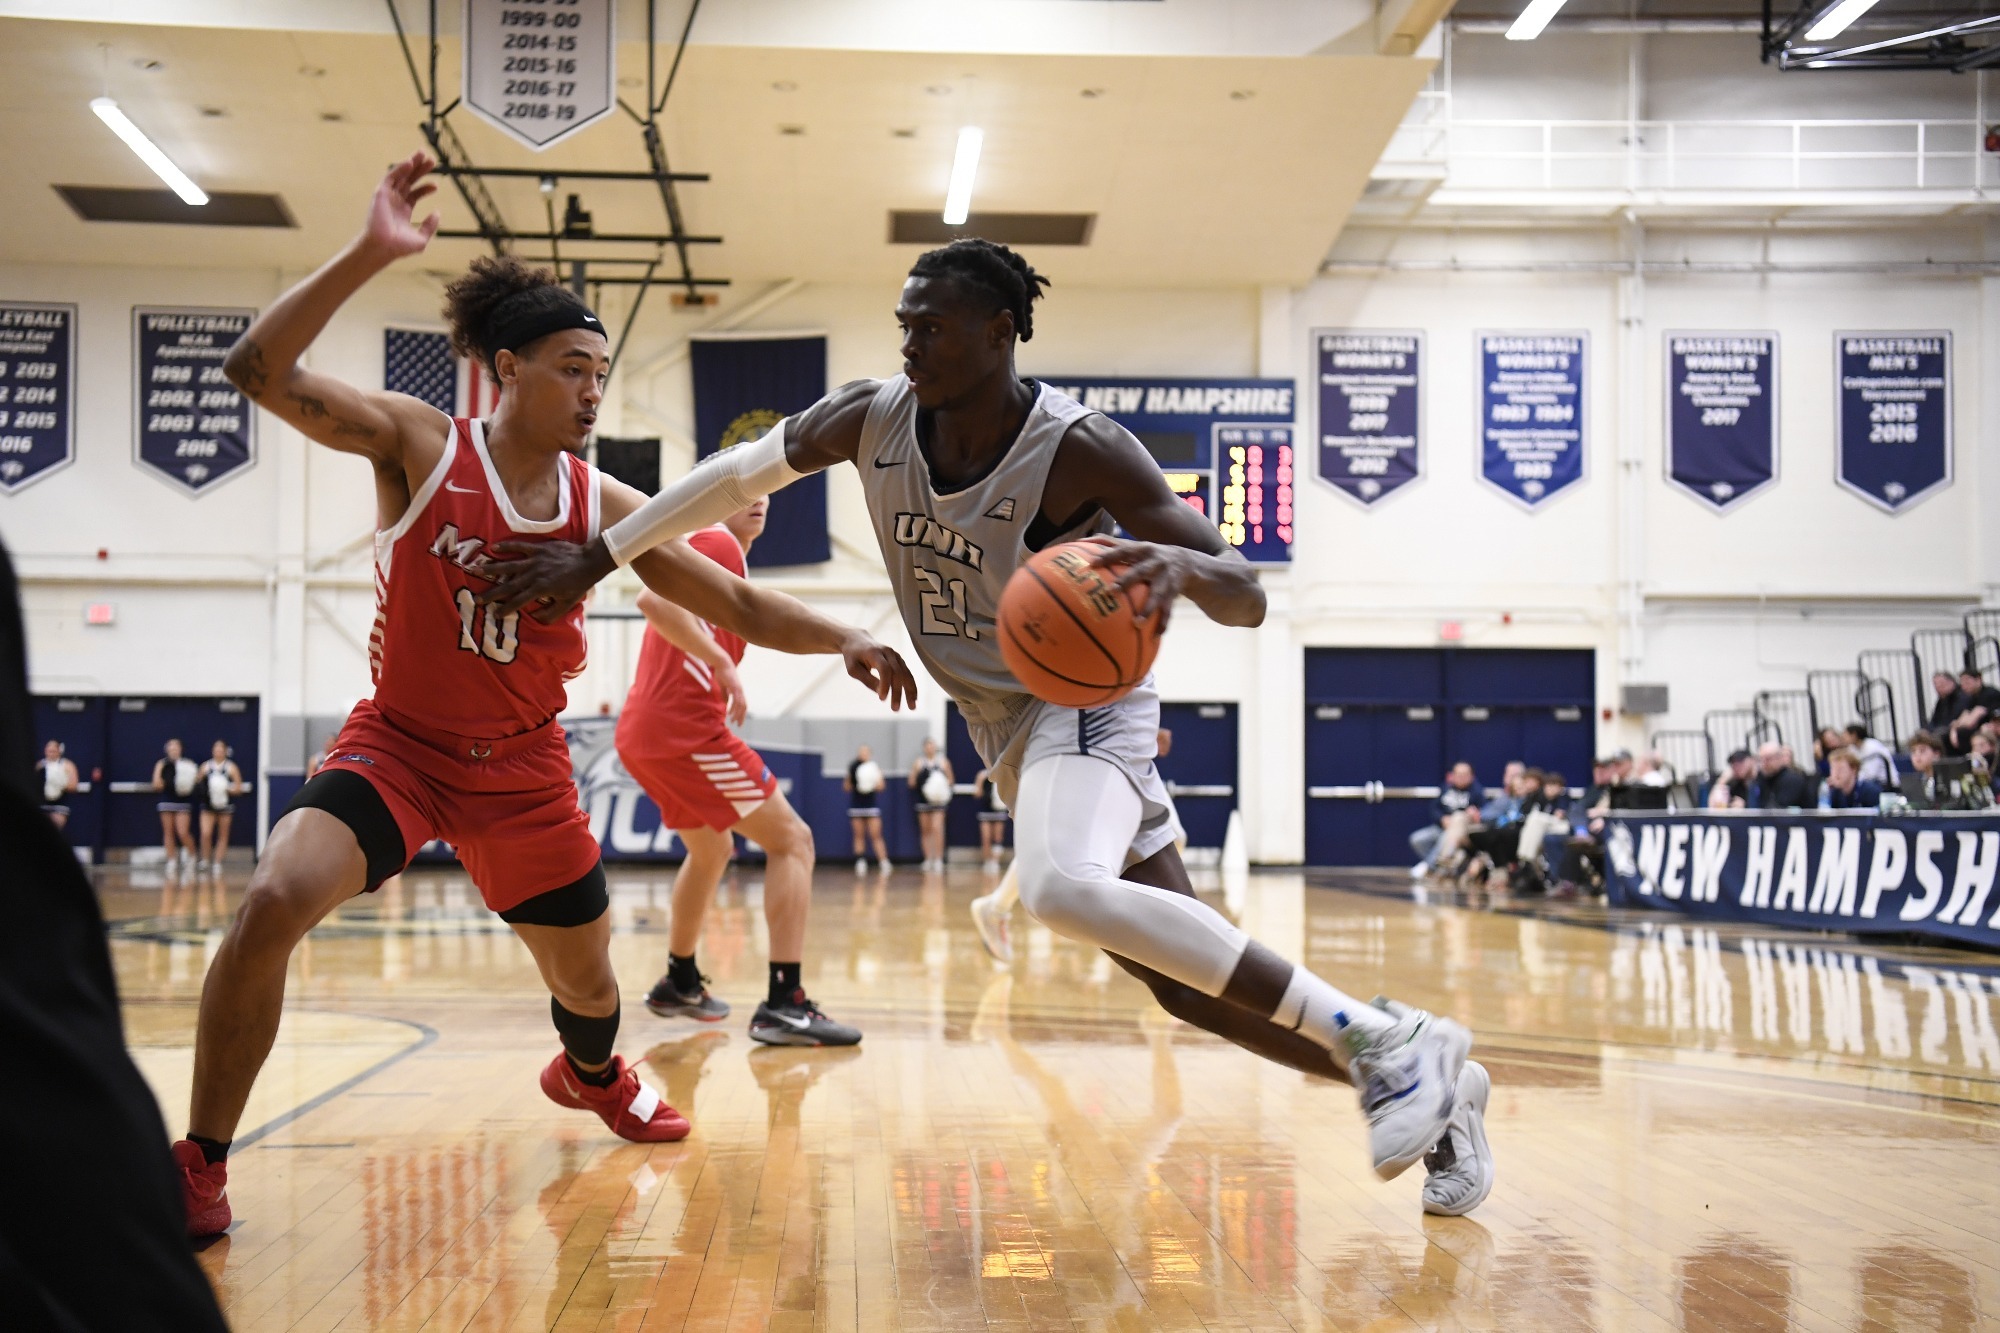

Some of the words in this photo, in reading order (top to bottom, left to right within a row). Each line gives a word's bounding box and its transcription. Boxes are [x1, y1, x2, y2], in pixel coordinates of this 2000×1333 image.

[501, 10, 581, 28] 1999-00
[503, 33, 577, 51] 2014-15
[503, 56, 577, 74] 2015-16
[503, 79, 577, 97] 2016-17
[503, 102, 577, 120] 2018-19
[147, 315, 245, 333] VOLLEYBALL
[1845, 338, 1941, 354] BASKETBALL
[15, 362, 57, 379] 2013
[1685, 355, 1758, 371] WOMEN'S
[1868, 354, 1919, 371] MEN'S
[13, 386, 57, 404] 2014
[199, 391, 241, 409] 2014
[1083, 386, 1144, 414] NEW
[1144, 387, 1293, 416] HAMPSHIRE
[13, 410, 57, 429] 2015
[1869, 402, 1918, 422] 2015
[199, 415, 241, 433] 2015
[1869, 423, 1918, 443] 2016
[0, 435, 33, 453] 016
[175, 439, 219, 458] 2016
[894, 512, 983, 574] UNH
[456, 586, 520, 665] 10
[1637, 824, 1731, 902] NEW
